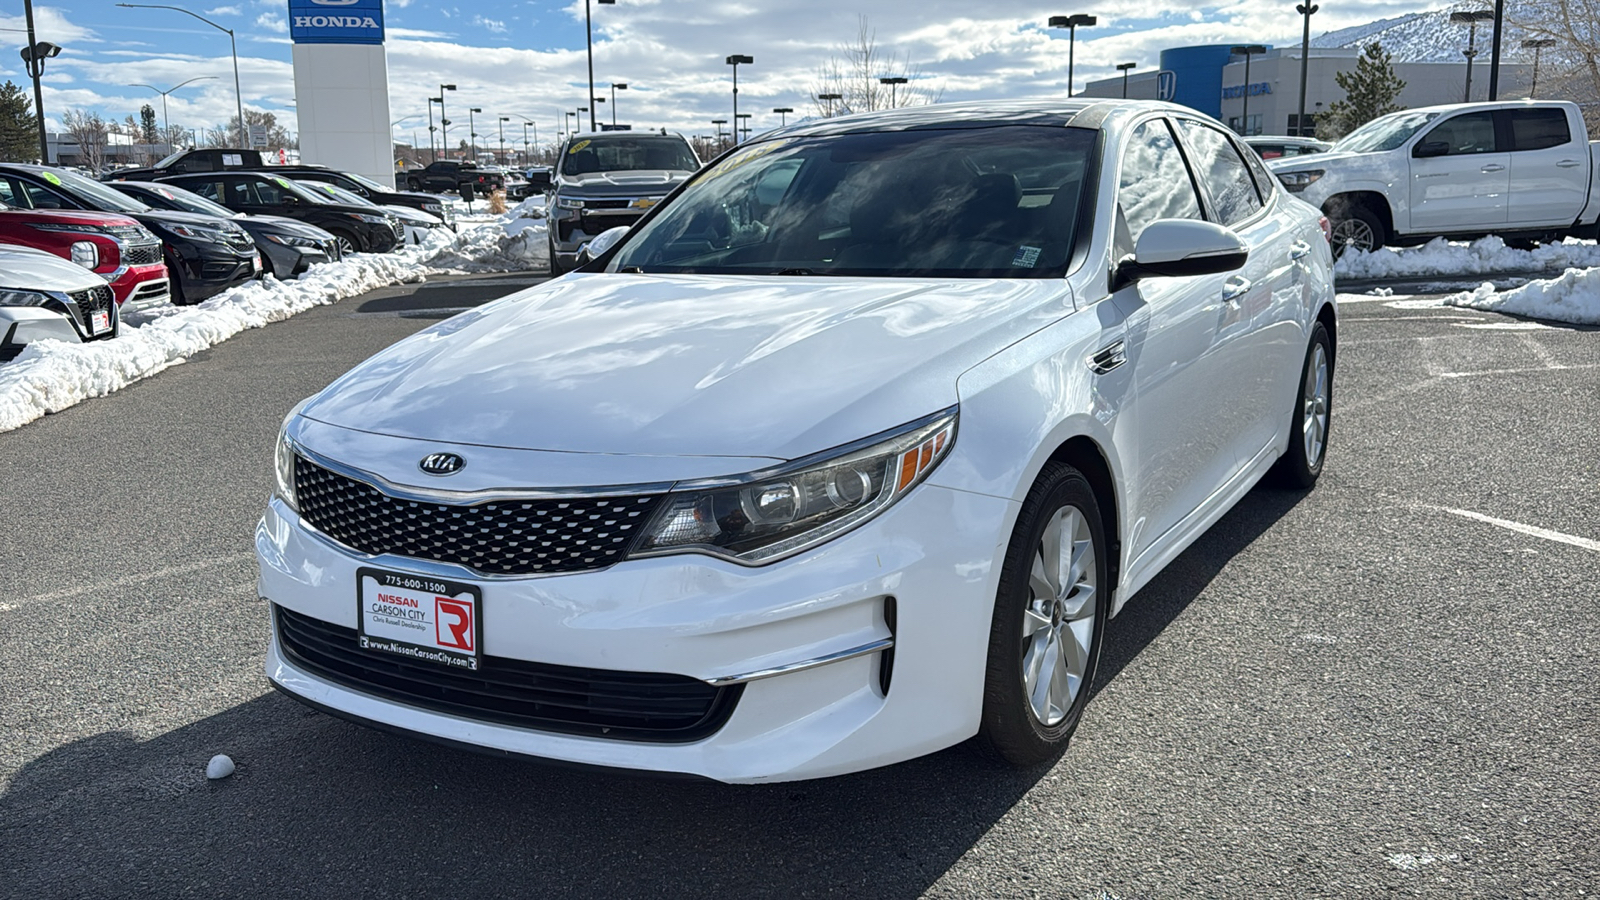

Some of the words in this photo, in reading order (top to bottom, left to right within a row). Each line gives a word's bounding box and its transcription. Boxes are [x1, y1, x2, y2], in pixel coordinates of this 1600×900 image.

[294, 16, 379, 29] HONDA
[1222, 82, 1273, 99] HONDA
[423, 454, 456, 470] KIA
[385, 575, 446, 593] 775-600-1500
[377, 593, 418, 608] NISSAN
[372, 603, 406, 618] CARSON
[408, 609, 426, 620] CITY
[372, 615, 384, 624] Chris
[386, 617, 400, 626] Russell
[401, 620, 427, 632] Dealership
[370, 641, 468, 666] www.NissanCarsonCity.com
